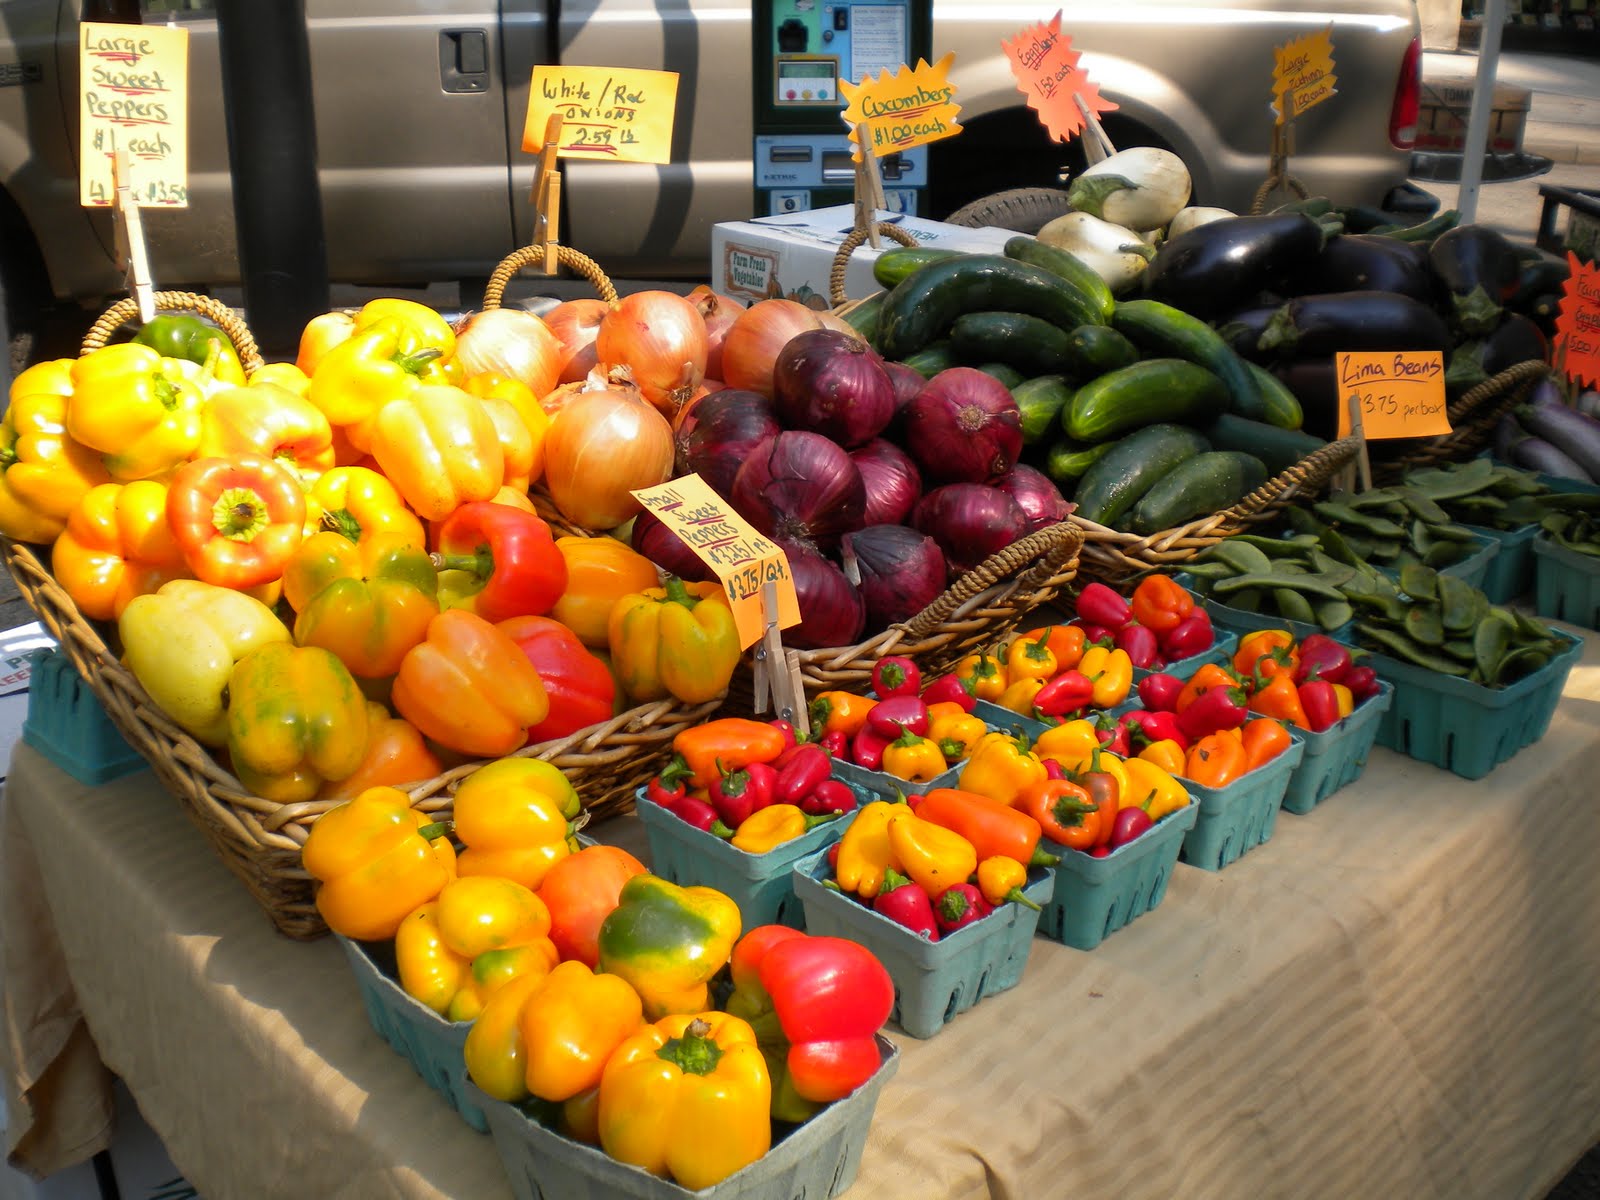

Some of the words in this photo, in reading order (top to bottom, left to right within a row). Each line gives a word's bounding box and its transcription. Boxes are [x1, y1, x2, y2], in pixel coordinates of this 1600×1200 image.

[84, 28, 154, 67] Large
[543, 78, 590, 99] White
[86, 92, 168, 121] Peppers
[913, 117, 947, 136] each
[128, 131, 172, 155] each
[90, 179, 105, 200] 4
[1342, 354, 1386, 384] Lima
[1393, 353, 1441, 377] Beans
[636, 488, 686, 507] Small
[678, 522, 739, 545] Peppers
